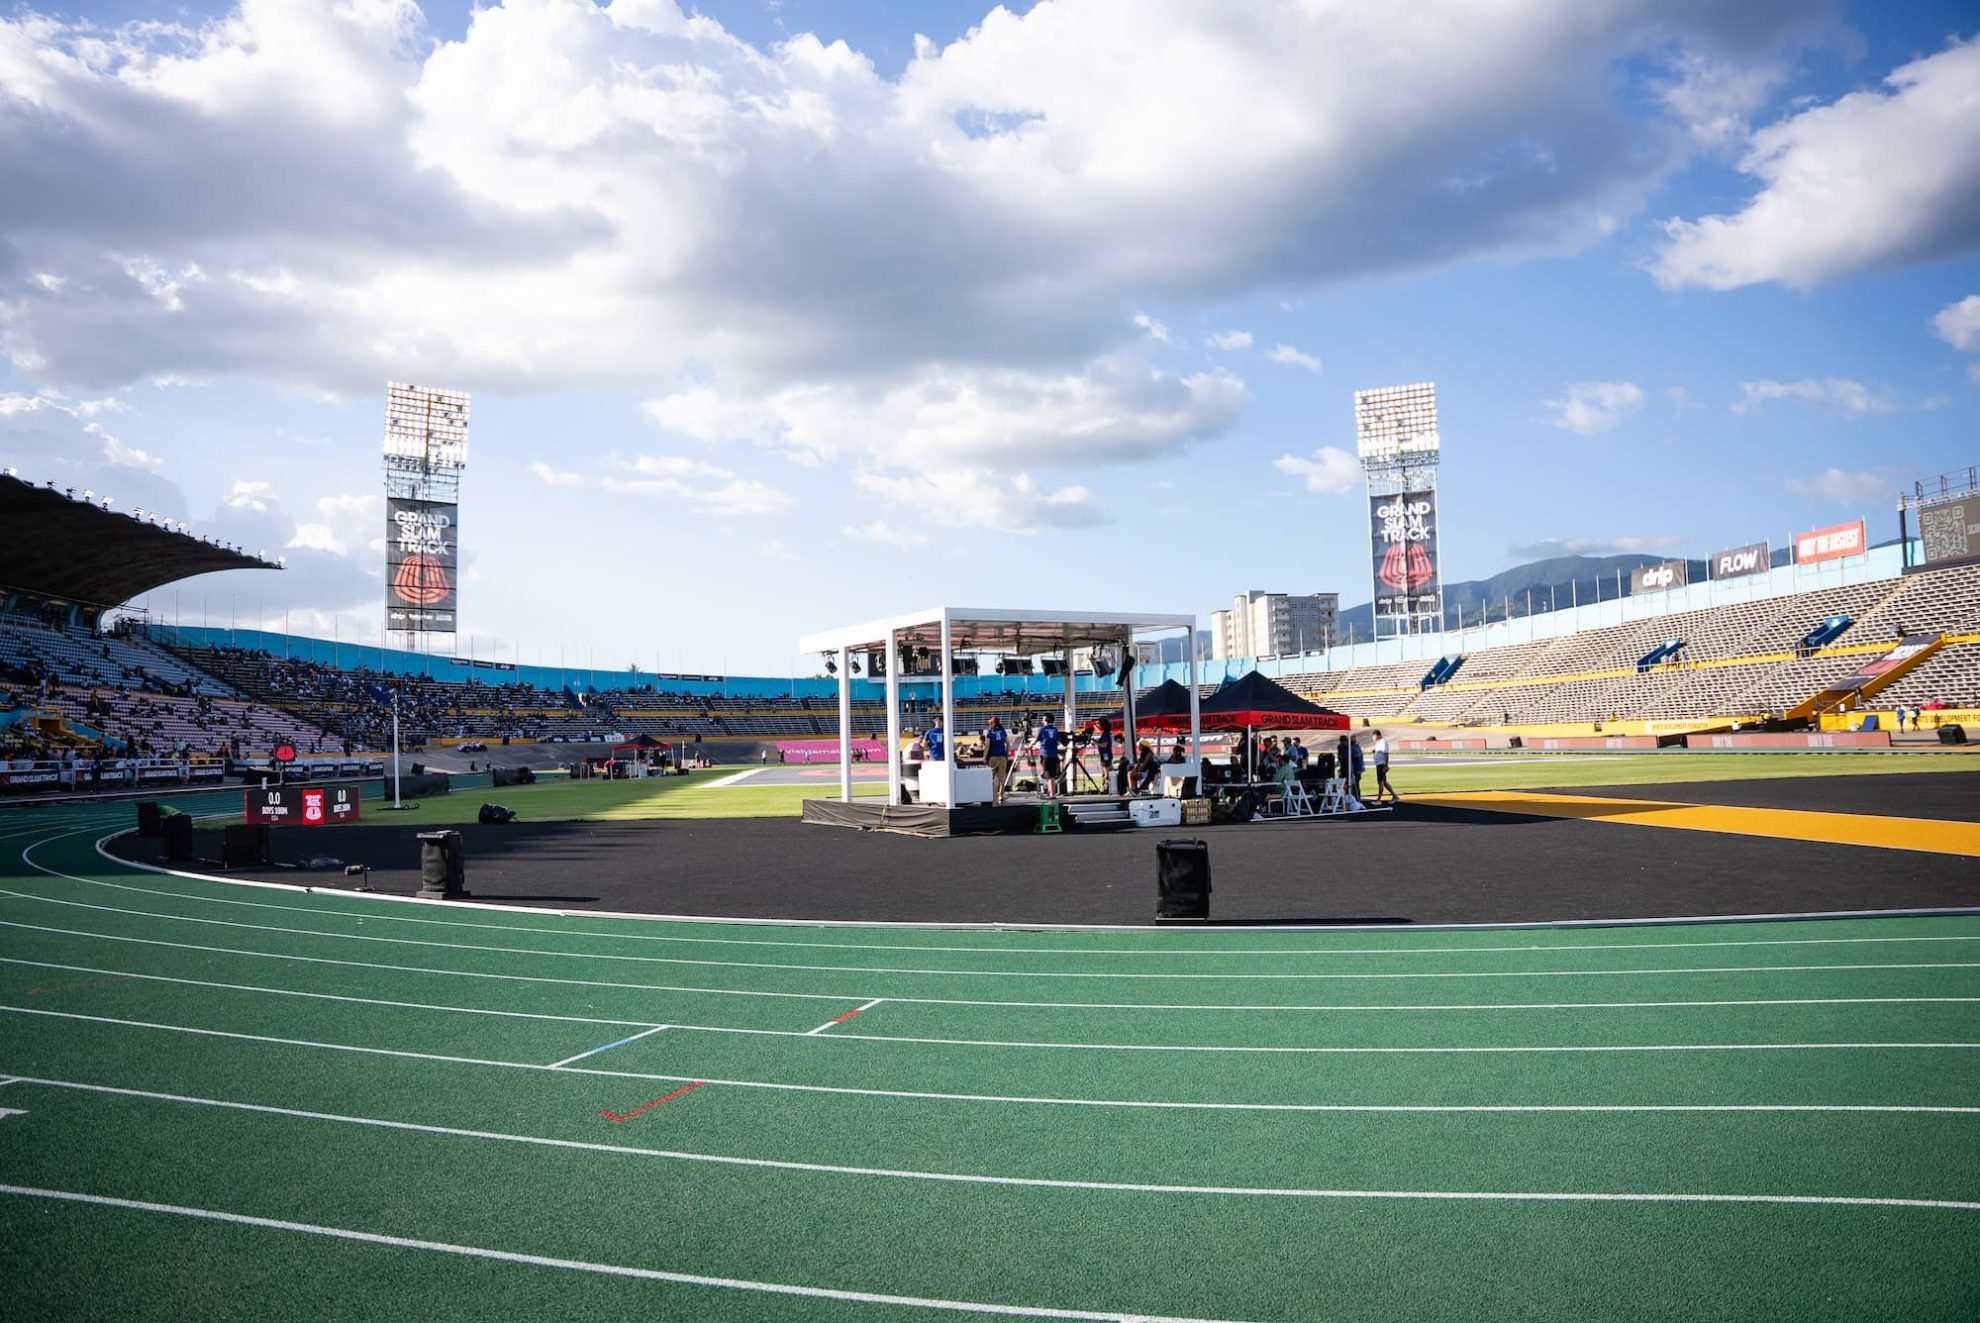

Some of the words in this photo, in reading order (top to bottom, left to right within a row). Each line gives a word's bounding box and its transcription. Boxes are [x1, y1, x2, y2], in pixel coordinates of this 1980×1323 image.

[1377, 502, 1431, 518] GRAND
[394, 511, 450, 528] GRAND
[1384, 515, 1423, 530] SLAM
[401, 525, 441, 540] SLAM
[1381, 526, 1433, 543] TRACK
[397, 538, 450, 555] TRACK
[1720, 550, 1759, 574] FLOW
[1642, 566, 1673, 587] drip
[1261, 714, 1291, 724] GRAND
[1292, 715, 1313, 725] SLAM
[1314, 716, 1338, 727] TRACK
[268, 791, 280, 805] 0.0
[261, 807, 274, 815] BOYS
